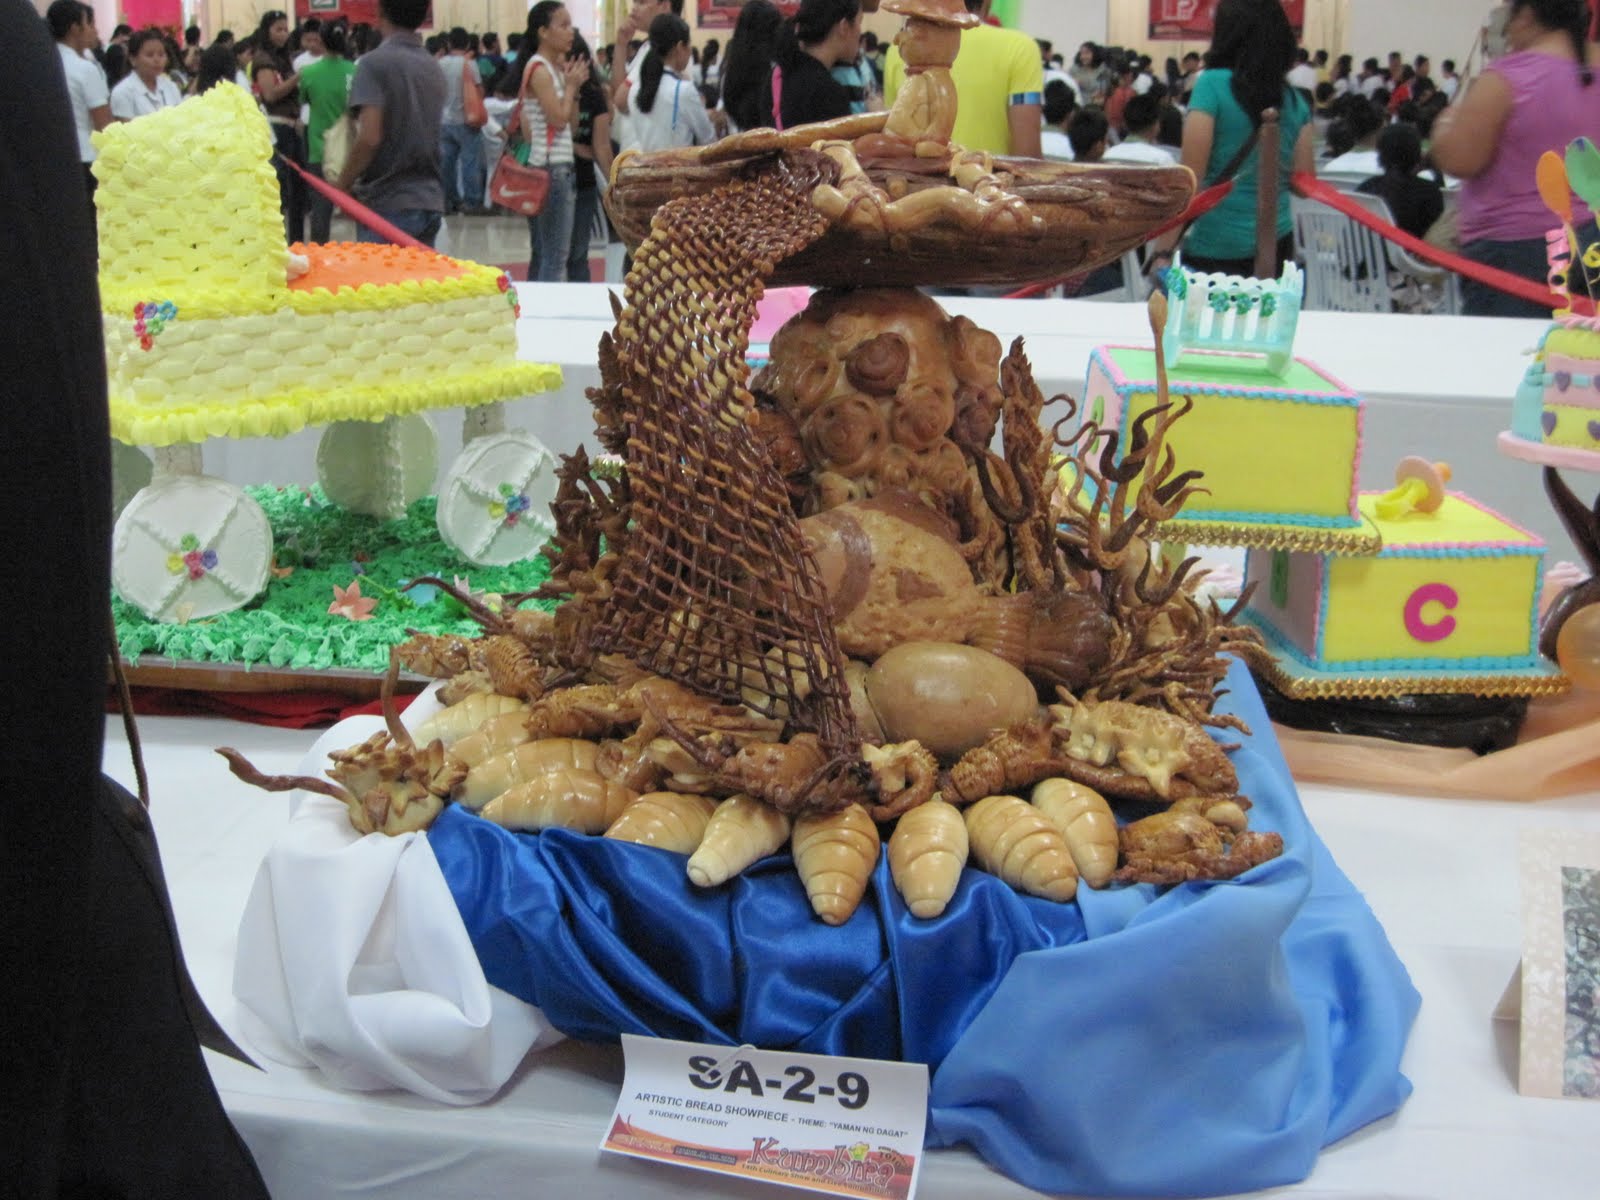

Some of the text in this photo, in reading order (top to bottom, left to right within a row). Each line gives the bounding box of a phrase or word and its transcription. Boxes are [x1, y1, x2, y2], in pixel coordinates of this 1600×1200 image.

[1403, 583, 1459, 643] C
[688, 1055, 870, 1110] SA-2-9
[635, 1092, 683, 1107] ARTISTIC
[685, 1099, 722, 1113] BREAD
[724, 1106, 789, 1123] SHOWPIECE
[798, 1117, 827, 1129] THEME:
[862, 1127, 875, 1135] NG
[648, 1109, 729, 1128] STUDENT CATEGORY
[759, 1167, 788, 1178] Culinary
[790, 1172, 809, 1181] Show
